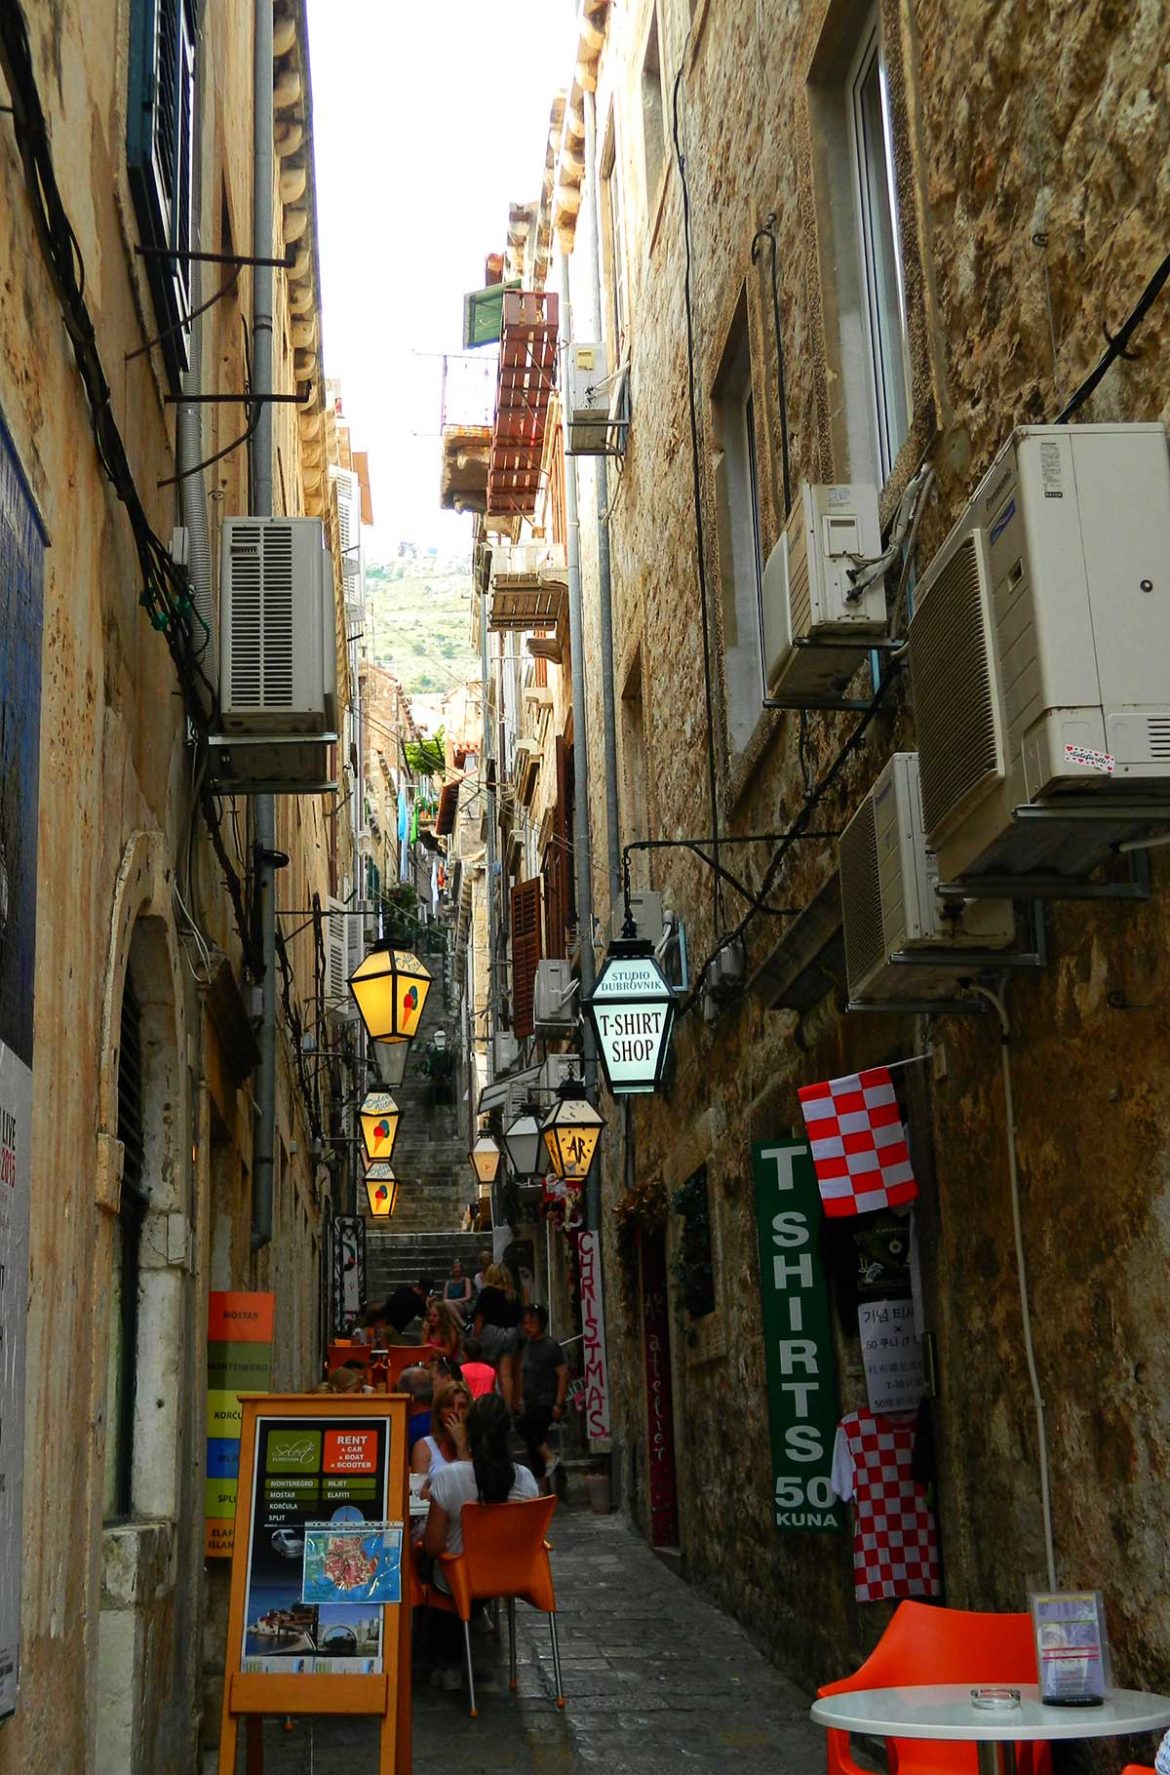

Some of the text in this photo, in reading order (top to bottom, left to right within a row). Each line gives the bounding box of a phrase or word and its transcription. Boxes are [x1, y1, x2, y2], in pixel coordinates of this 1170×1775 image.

[611, 970, 650, 982] STUDIO
[601, 980, 662, 992] DUBROVNIK
[600, 1012, 661, 1036] T-SHIRT
[612, 1040, 654, 1062] SHOP
[2, 1110, 16, 1150] LIVE
[223, 1311, 258, 1319] MOSTAR
[214, 1410, 242, 1420] KORČU
[337, 1435, 368, 1445] RENT
[775, 1476, 836, 1508] 50
[218, 1494, 236, 1503] SPLI
[776, 1512, 838, 1527] KUNA
[211, 1528, 233, 1537] ELAF
[208, 1540, 234, 1549] ISLAN
